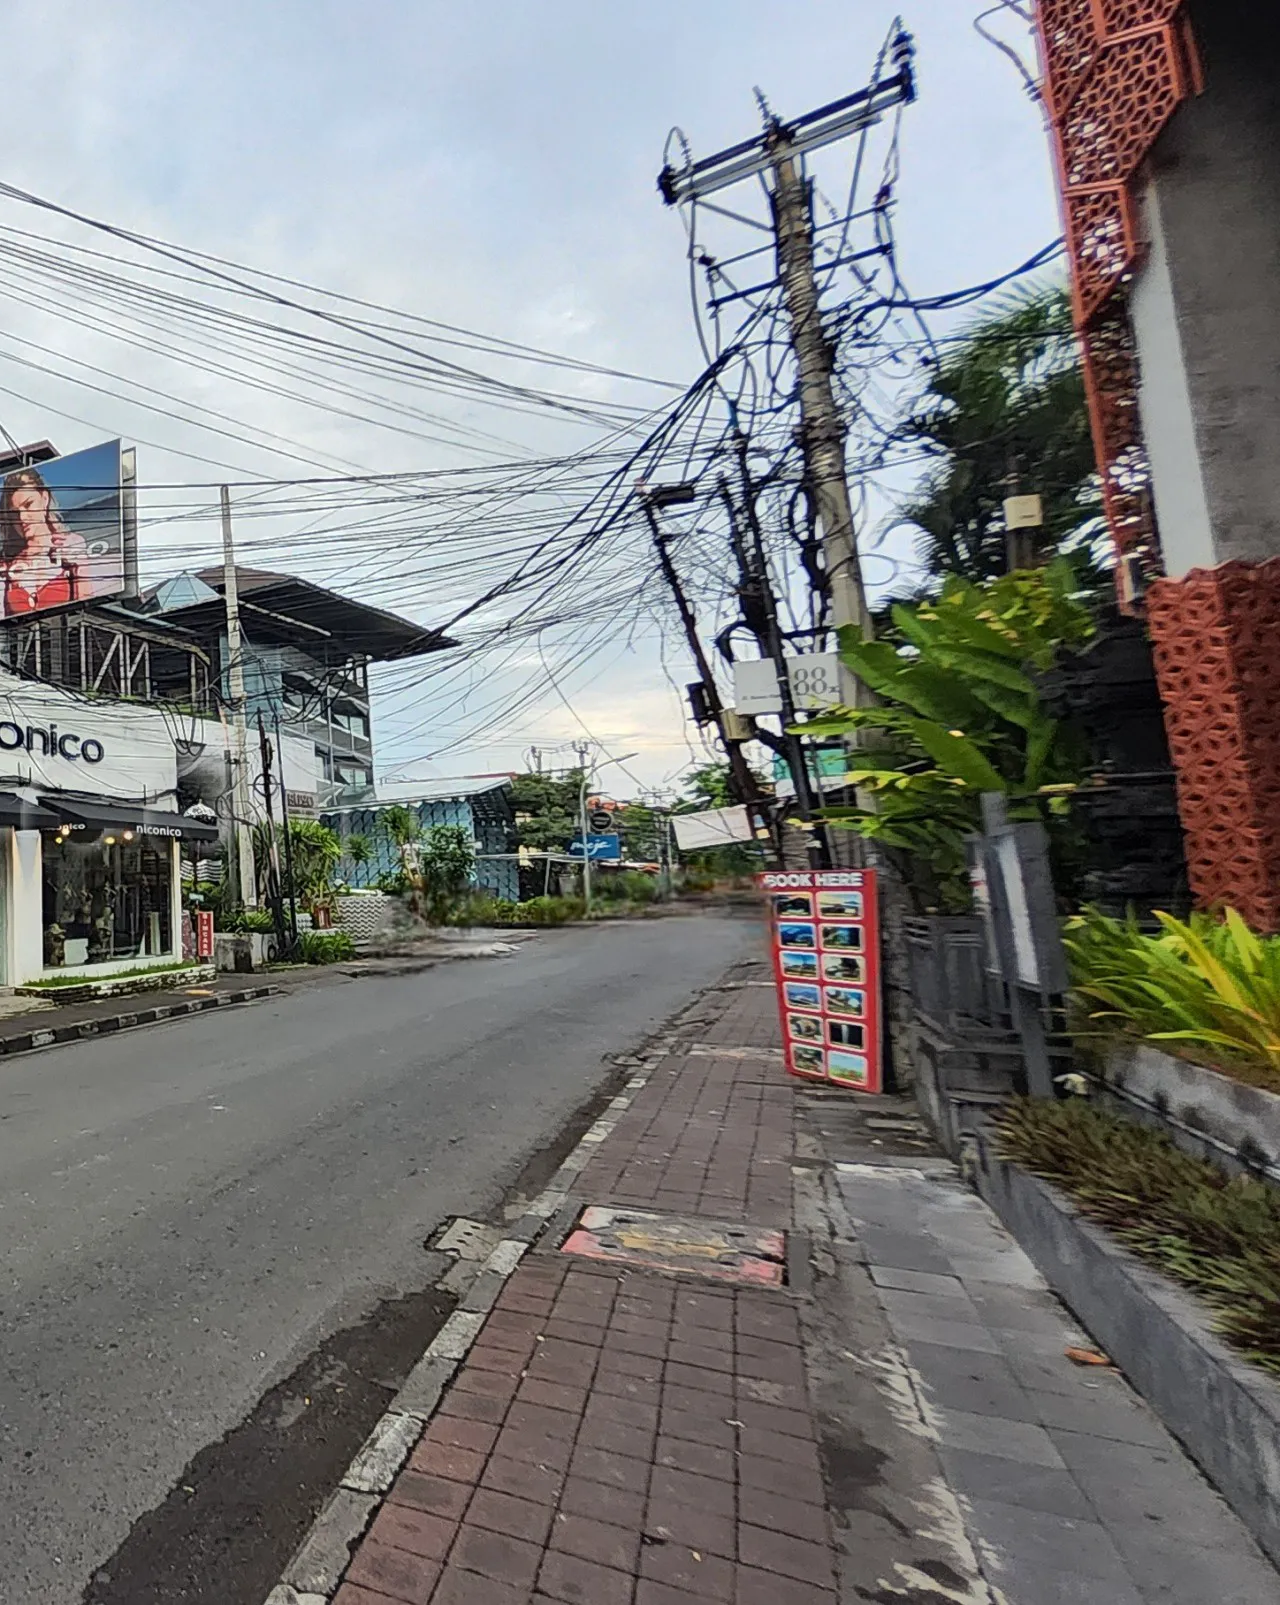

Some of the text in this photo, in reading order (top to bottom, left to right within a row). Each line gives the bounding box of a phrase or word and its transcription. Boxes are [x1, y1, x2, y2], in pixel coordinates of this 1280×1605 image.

[136, 823, 182, 837] niconico
[763, 872, 864, 887] BOOK HERE
